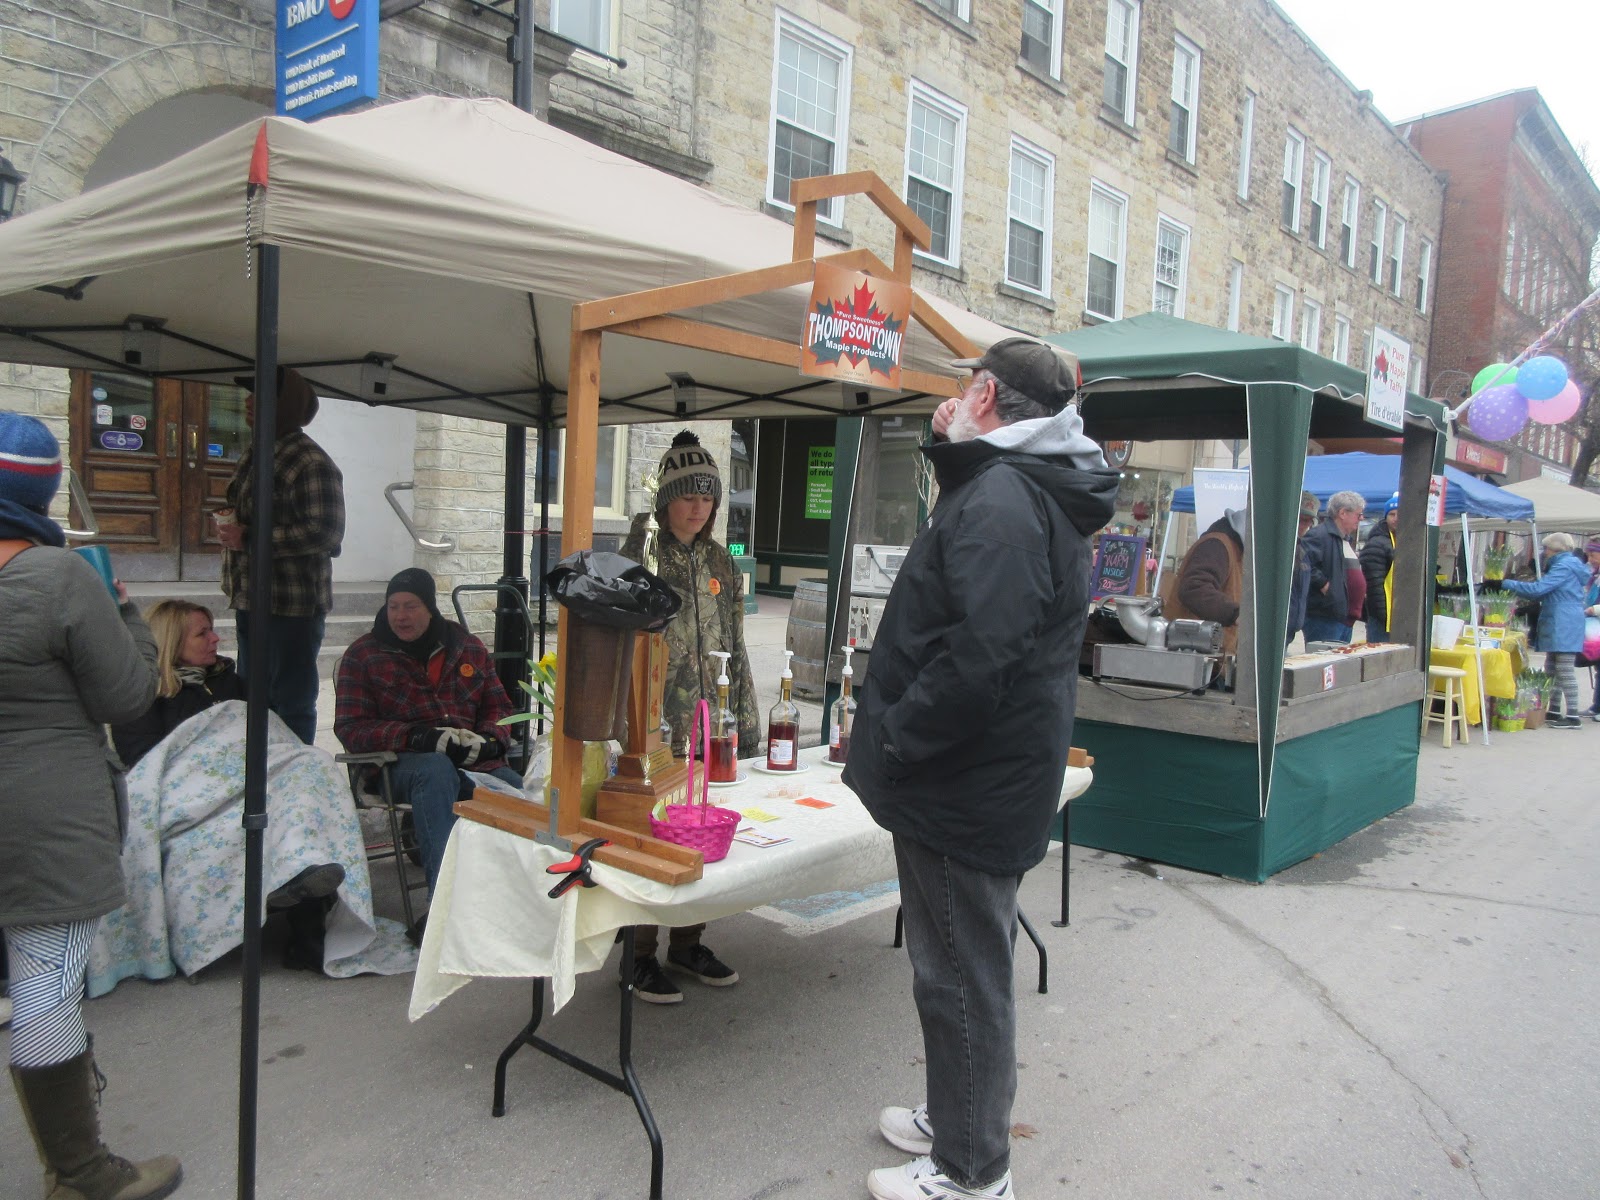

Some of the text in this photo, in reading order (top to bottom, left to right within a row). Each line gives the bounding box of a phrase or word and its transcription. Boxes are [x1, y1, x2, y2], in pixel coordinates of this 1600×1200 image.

[286, 0, 325, 28] BMO
[808, 312, 903, 366] THOMPSONTOWN
[825, 340, 886, 359] Maple Products
[1392, 347, 1405, 363] Pure
[1389, 362, 1406, 380] Maple
[1389, 379, 1403, 396] Taffy
[1371, 401, 1381, 417] Tire
[811, 450, 833, 458] We do
[658, 451, 719, 476] AIDE
[810, 459, 819, 467] all
[729, 544, 745, 556] OPEN
[1102, 567, 1126, 578] INSIDE
